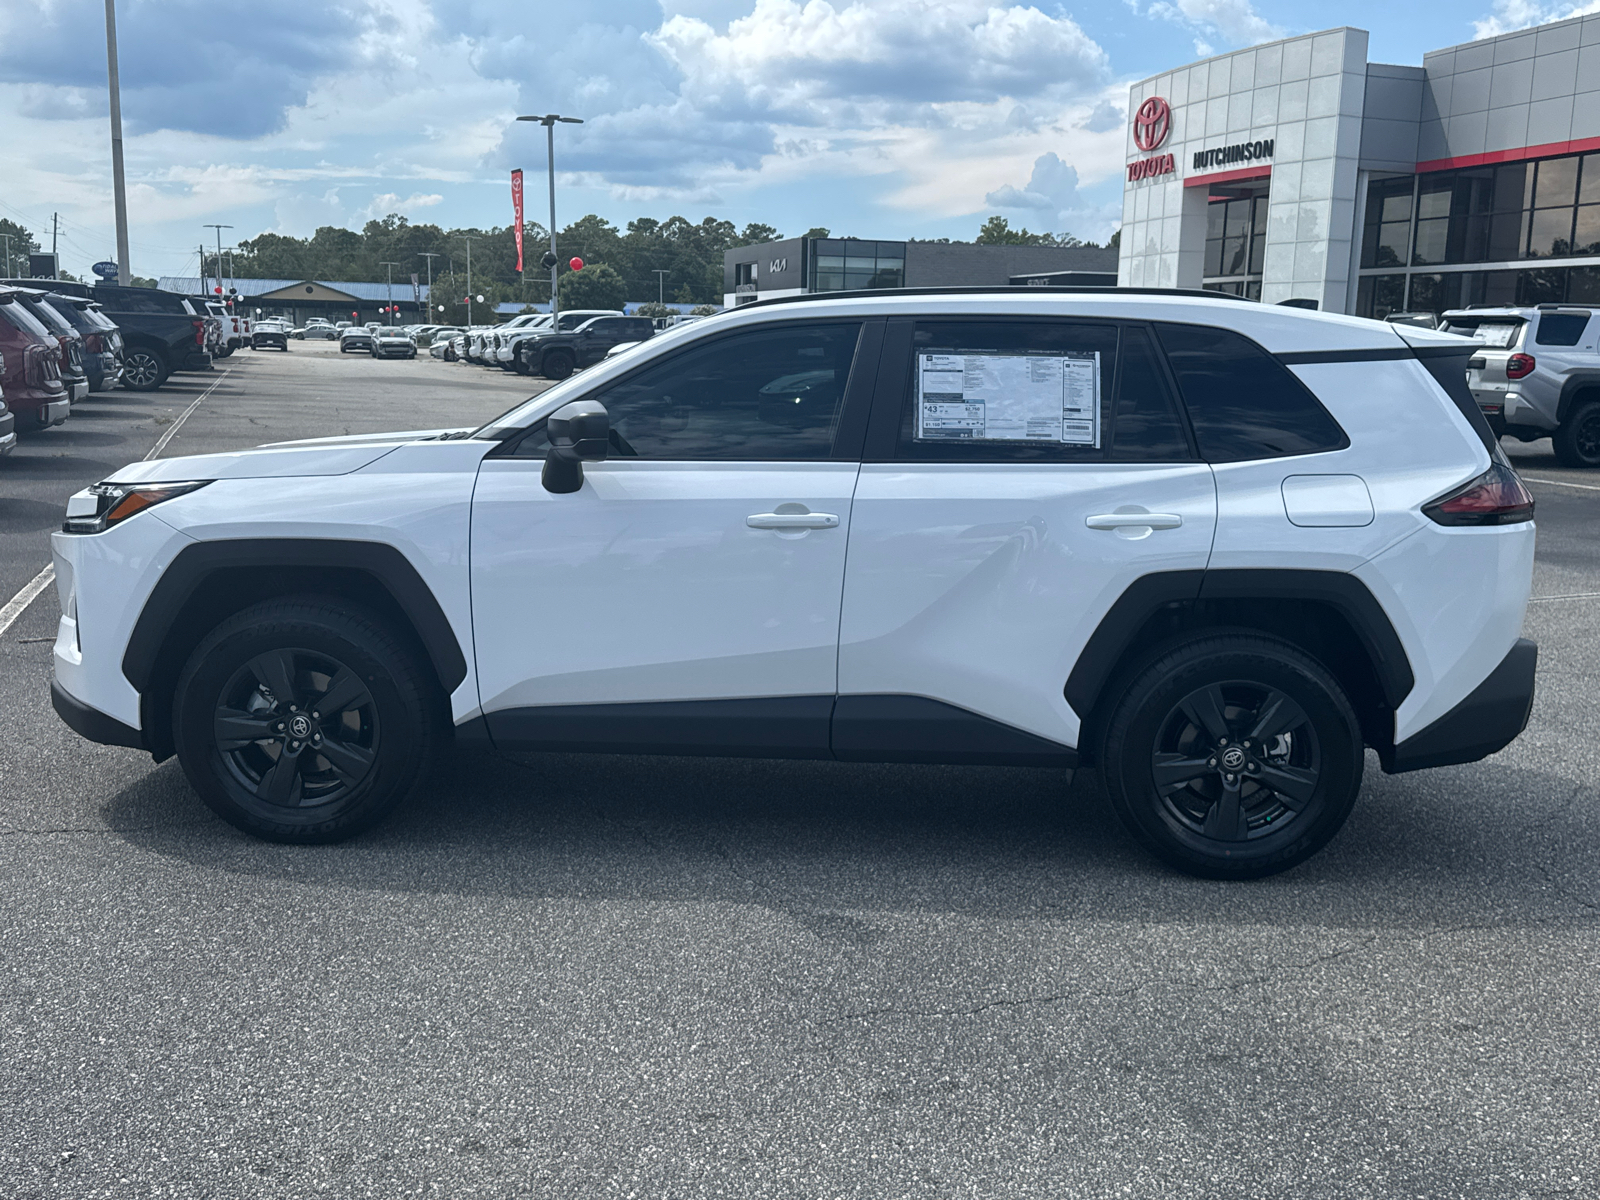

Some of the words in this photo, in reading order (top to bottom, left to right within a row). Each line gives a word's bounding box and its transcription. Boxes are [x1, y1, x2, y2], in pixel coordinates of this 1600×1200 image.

[1127, 153, 1175, 182] TOYOTA
[1193, 139, 1274, 169] HUTCHINSON
[770, 258, 787, 273] KIA
